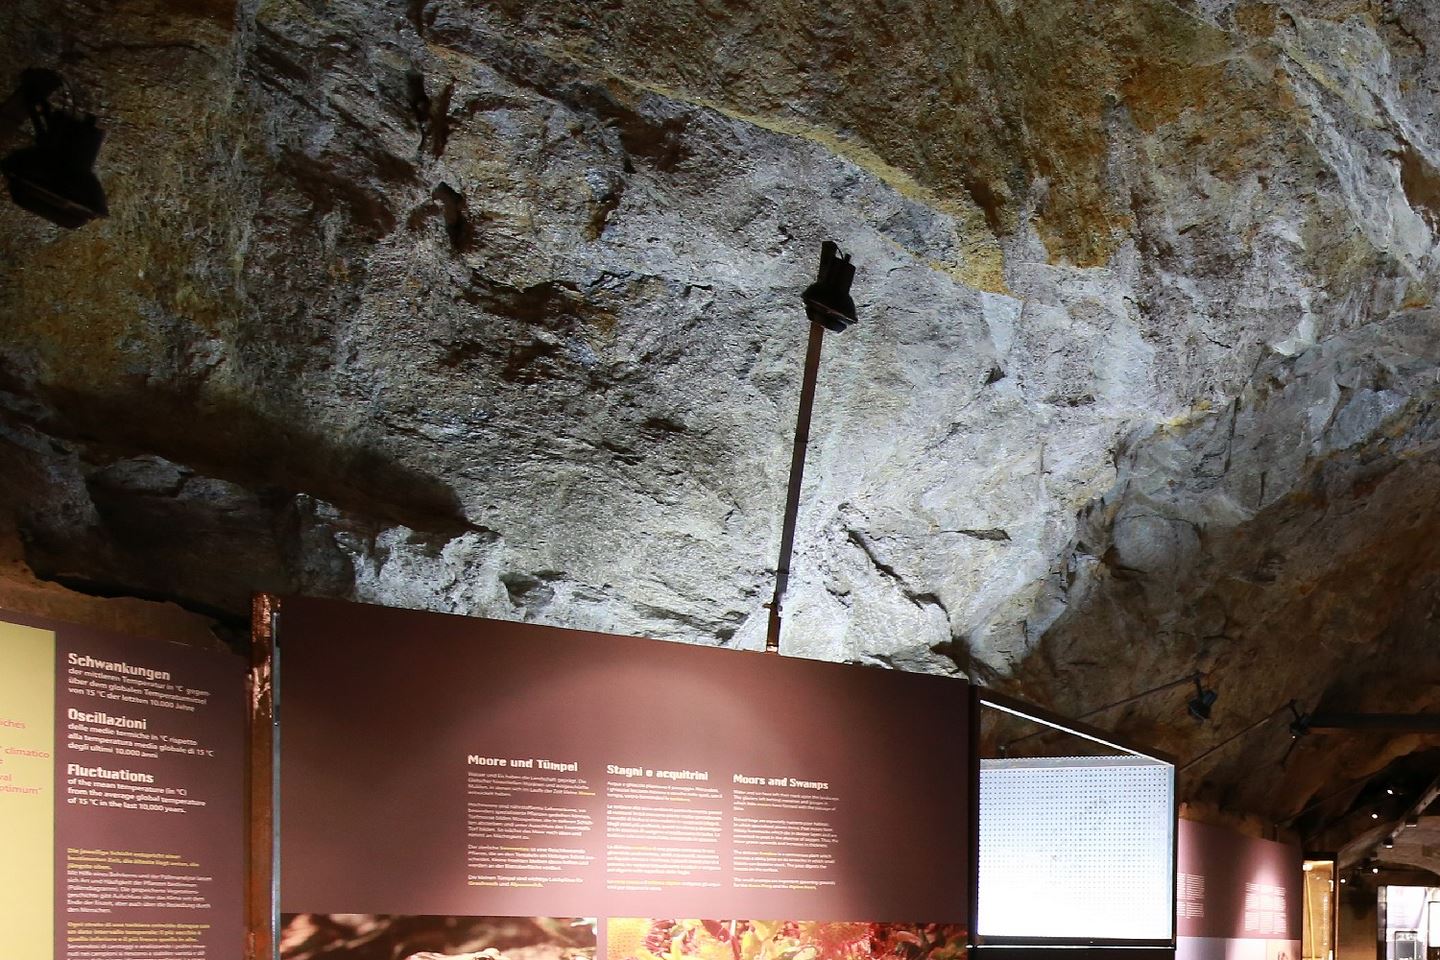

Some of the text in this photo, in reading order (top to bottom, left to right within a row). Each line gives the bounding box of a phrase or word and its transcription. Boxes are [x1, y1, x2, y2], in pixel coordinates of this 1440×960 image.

[68, 652, 171, 681] Schwankungen
[68, 708, 147, 730] Oscillazioni
[4, 747, 50, 759] climatico
[68, 763, 154, 783] Fluctuations
[467, 754, 578, 773] Moore und Tümpel
[607, 764, 708, 782] Stagni e acquitrini
[68, 778, 77, 786] of
[78, 779, 92, 787] the
[94, 781, 116, 789] mean
[117, 782, 164, 794] temperature
[166, 787, 175, 795] (in
[733, 773, 829, 791] Moors and Swamps
[68, 787, 206, 806] from the average global temperature
